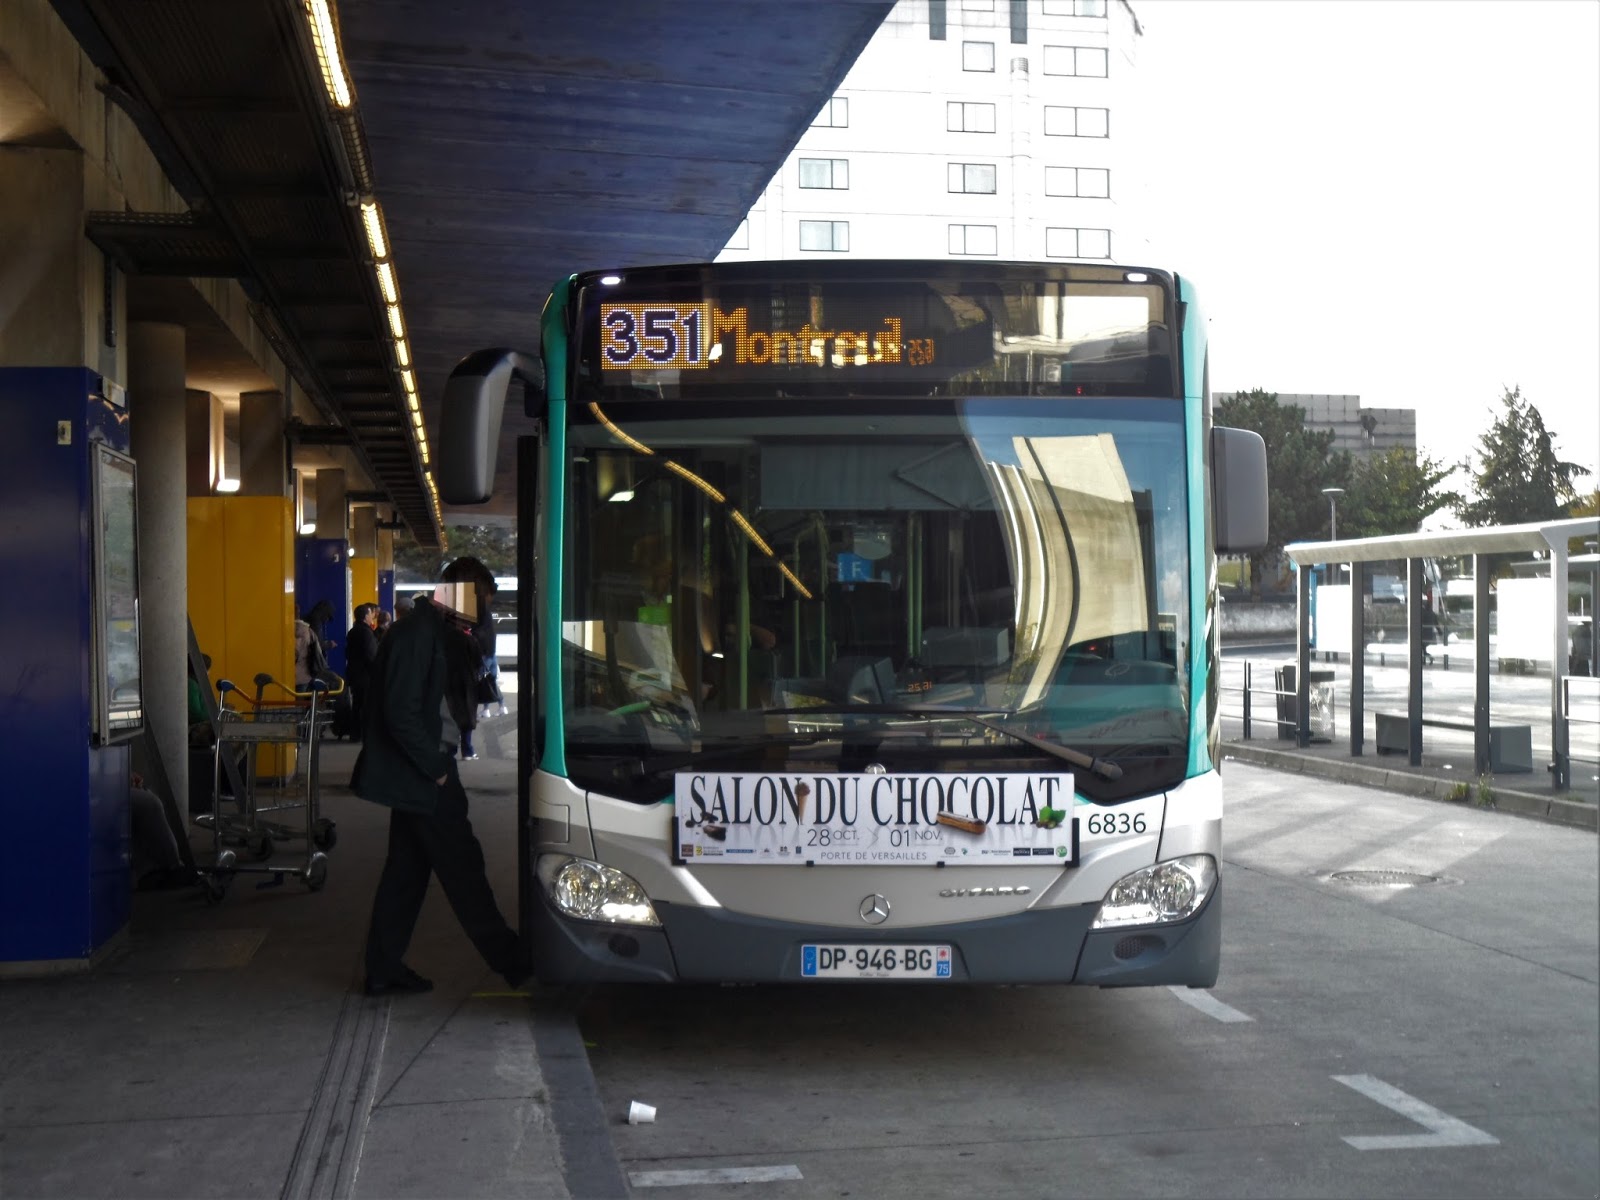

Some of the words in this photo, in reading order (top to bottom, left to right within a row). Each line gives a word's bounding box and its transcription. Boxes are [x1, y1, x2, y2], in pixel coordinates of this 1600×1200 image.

[604, 308, 701, 363] 351
[690, 775, 803, 826] SALON
[812, 777, 860, 826] DU
[871, 776, 1060, 826] CHOCOLAT
[1088, 813, 1147, 835] 6836
[807, 829, 831, 847] 28
[833, 830, 860, 841] OCT.
[890, 830, 910, 848] 01
[914, 830, 943, 841] NOV.
[820, 851, 853, 860] PORTE
[856, 852, 867, 860] DE
[870, 852, 927, 861] VERSAILLES
[937, 963, 949, 974] 75
